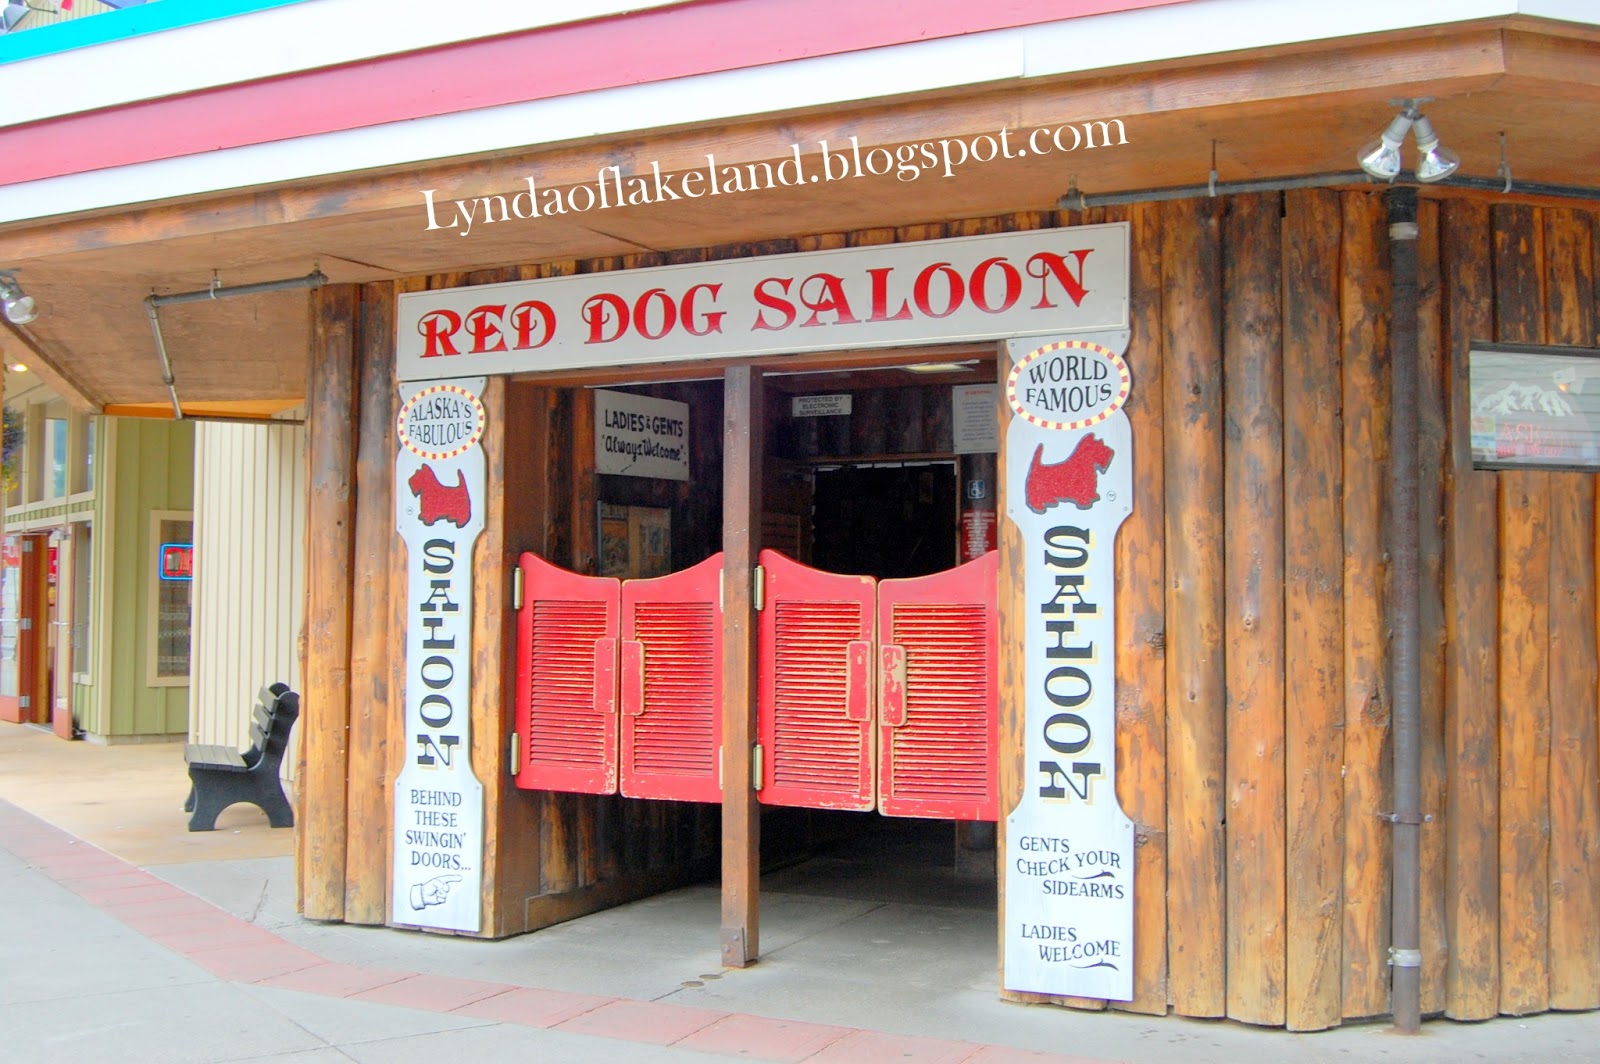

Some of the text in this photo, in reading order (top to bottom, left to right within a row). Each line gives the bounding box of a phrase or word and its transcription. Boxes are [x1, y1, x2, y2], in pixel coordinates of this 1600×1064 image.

[418, 248, 1095, 359] RED DOG SALOON
[1029, 355, 1108, 385] WORLD
[409, 397, 472, 423] ALASKA'S
[802, 402, 839, 410] ELECTRONIC
[1026, 383, 1112, 413] FAMOUS
[409, 421, 472, 446] FABULOUS
[605, 409, 644, 433] LADIES
[652, 416, 683, 437] GENTS
[417, 538, 461, 768] SALOON
[1039, 525, 1103, 802] SALOON
[410, 789, 462, 807] BEHIND
[414, 810, 458, 828] THESE
[405, 829, 466, 849] SWINGIN'
[1019, 836, 1070, 853] GENTS
[411, 850, 471, 871] DOORS...
[1016, 850, 1122, 877] CHECK YOUR
[1042, 879, 1125, 900] SIDEARMS
[1021, 923, 1077, 942] LADIES
[1039, 939, 1121, 963] WELCOME
